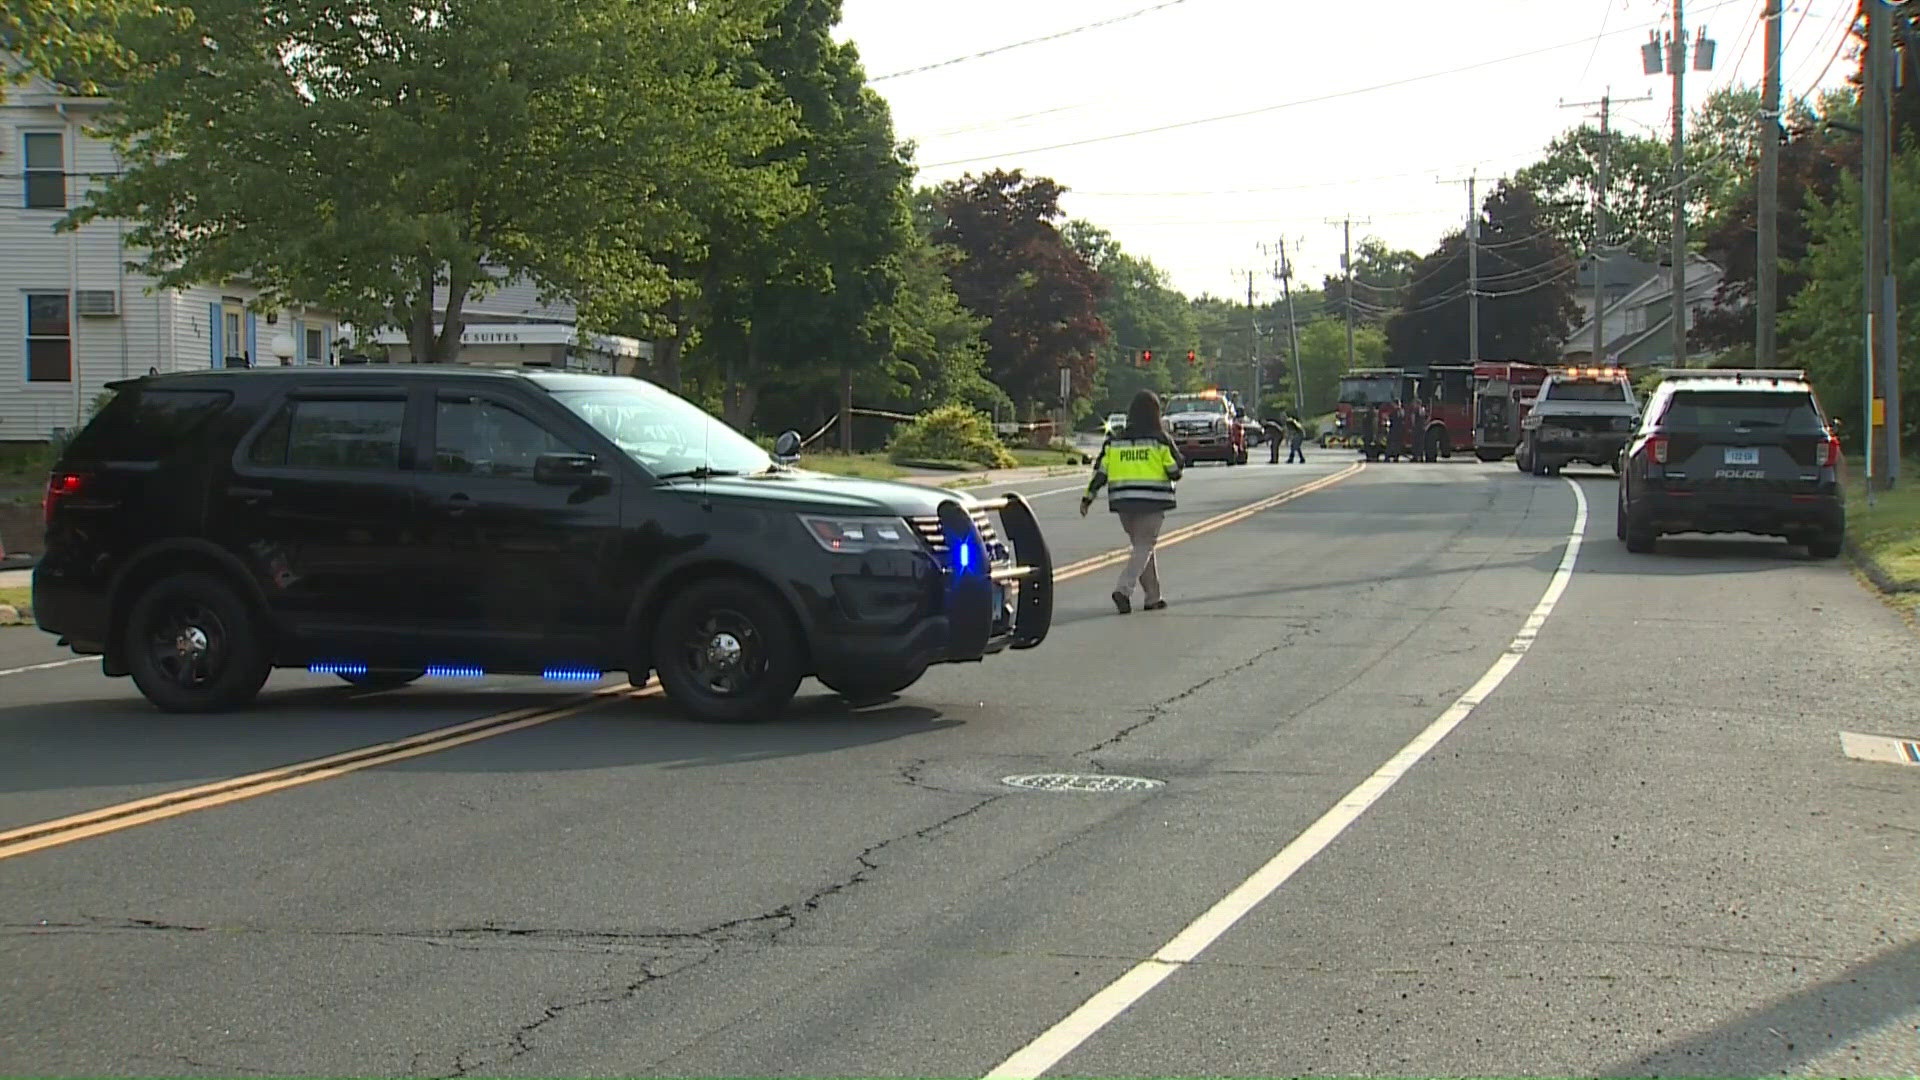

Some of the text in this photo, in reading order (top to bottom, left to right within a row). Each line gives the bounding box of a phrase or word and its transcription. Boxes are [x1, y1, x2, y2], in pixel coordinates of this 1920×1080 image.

[474, 333, 518, 341] SUITES
[1120, 449, 1149, 461] POLICE
[1715, 470, 1765, 479] POLICE
